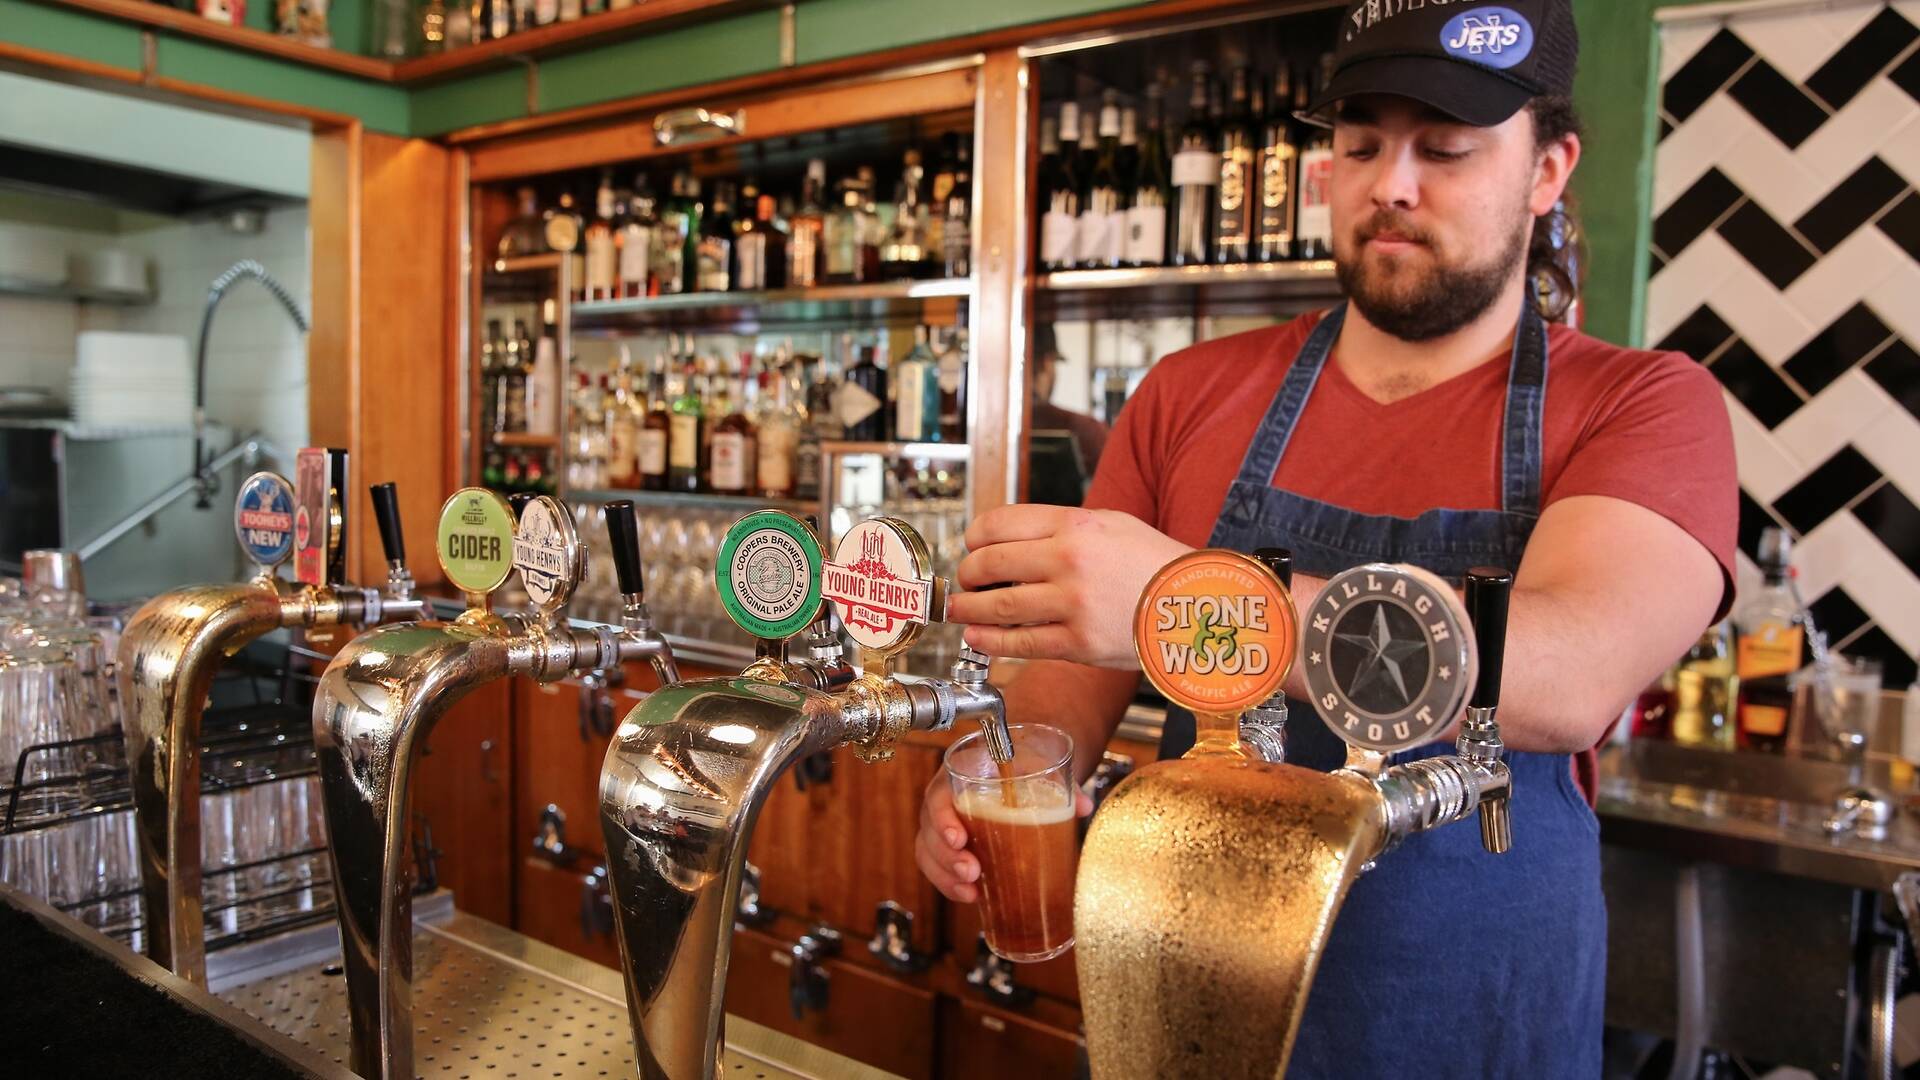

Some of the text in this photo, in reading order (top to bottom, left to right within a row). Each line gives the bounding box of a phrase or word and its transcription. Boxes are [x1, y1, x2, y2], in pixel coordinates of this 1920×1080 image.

[1450, 24, 1520, 49] JETS
[242, 512, 289, 529] TOOHEYS
[248, 530, 282, 547] NEW
[448, 534, 501, 561] CIDER
[516, 545, 561, 572] YOUNG HENRYS
[736, 535, 769, 571] COOPERS
[770, 535, 805, 572] BREWERY
[827, 570, 919, 611] YOUNG HENRYS
[1171, 568, 1255, 590] HANDCRAFTED
[737, 580, 772, 615] ORIGINAL
[773, 598, 795, 615] PALE
[793, 581, 804, 601] ALE
[1312, 574, 1450, 643] KILLAGH
[858, 607, 880, 625] REAL ALE
[1155, 595, 1269, 632] STONE
[1158, 640, 1270, 675] WOOD
[1180, 679, 1254, 698] PACIFIC ALE
[1322, 692, 1435, 742] STOUT
